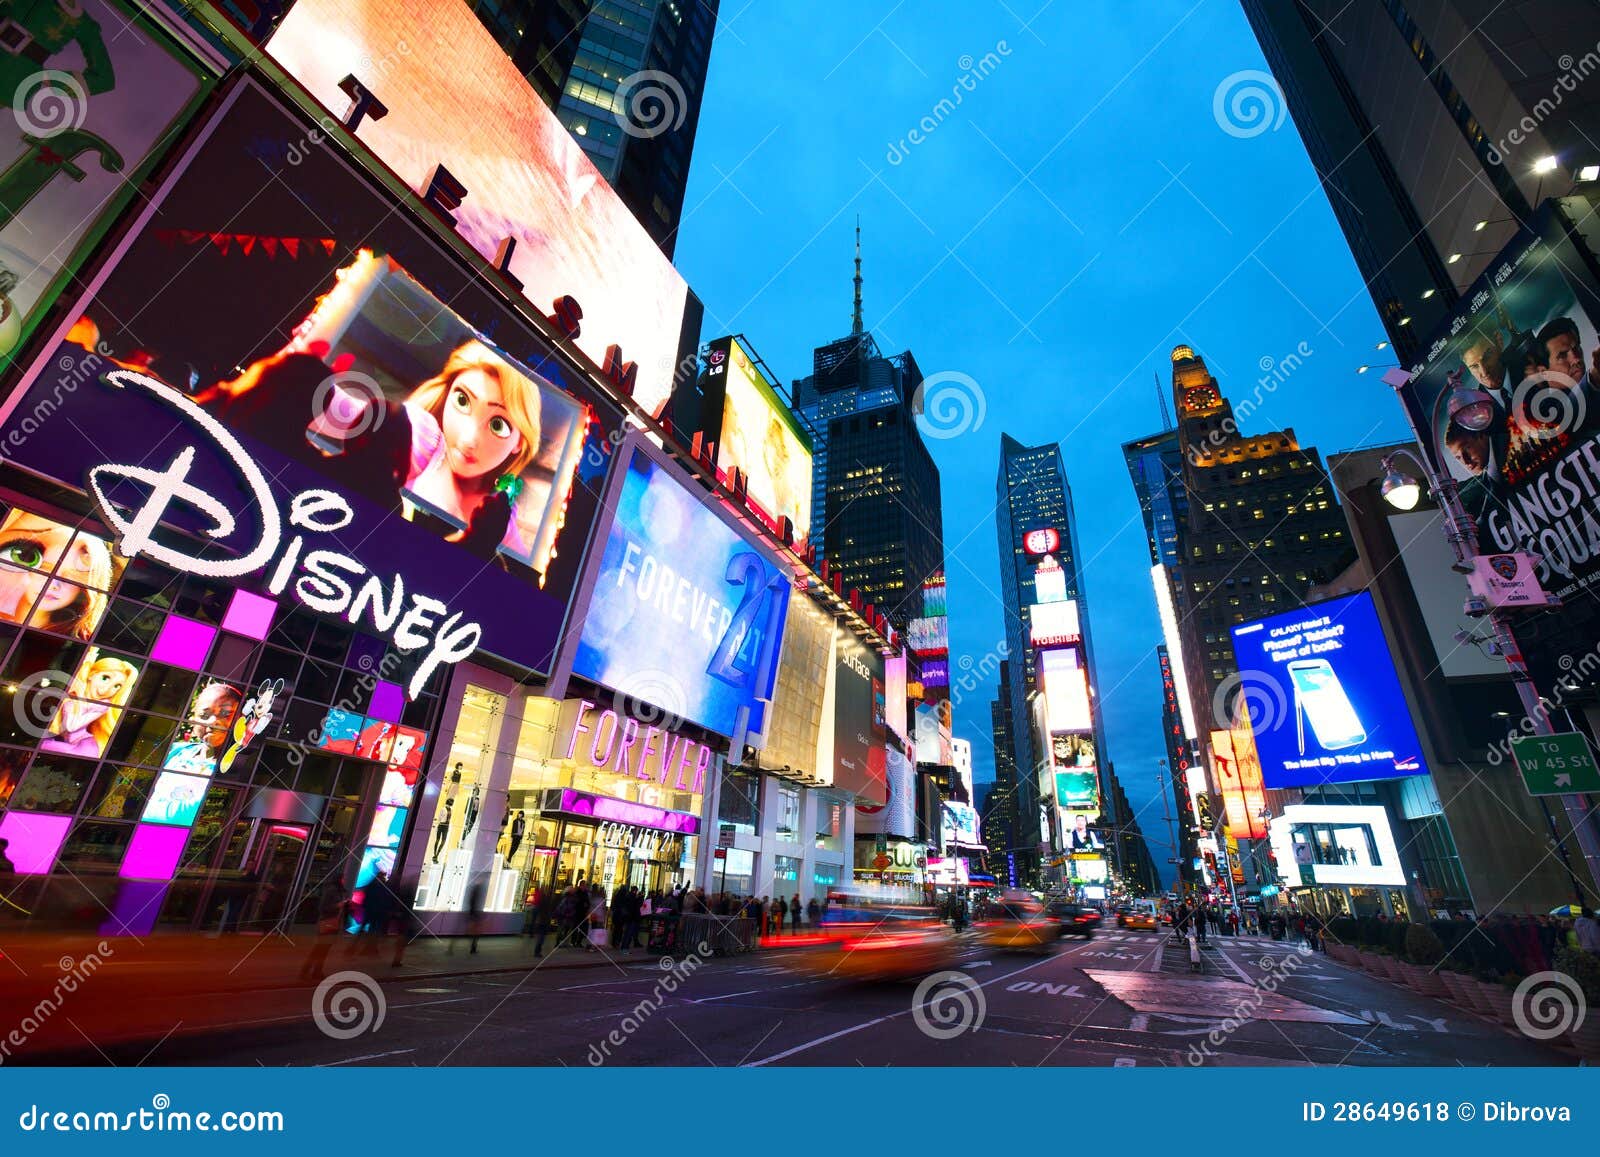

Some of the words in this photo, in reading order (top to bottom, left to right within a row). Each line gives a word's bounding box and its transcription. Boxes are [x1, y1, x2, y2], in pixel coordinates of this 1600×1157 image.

[1495, 265, 1512, 287] PENN
[709, 365, 723, 376] LG
[1488, 434, 1600, 552] GANGSTE
[1526, 496, 1600, 584] SQUA
[616, 541, 734, 647] FOREVER
[1035, 633, 1080, 646] TOSHIBA
[1270, 623, 1302, 637] GALAXY
[1298, 644, 1311, 656] of
[567, 700, 711, 793] FOREVER
[1523, 759, 1538, 770] W
[1545, 757, 1566, 769] 45
[1570, 755, 1591, 767] St
[660, 832, 675, 852] 21
[1006, 981, 1090, 999] ONL
